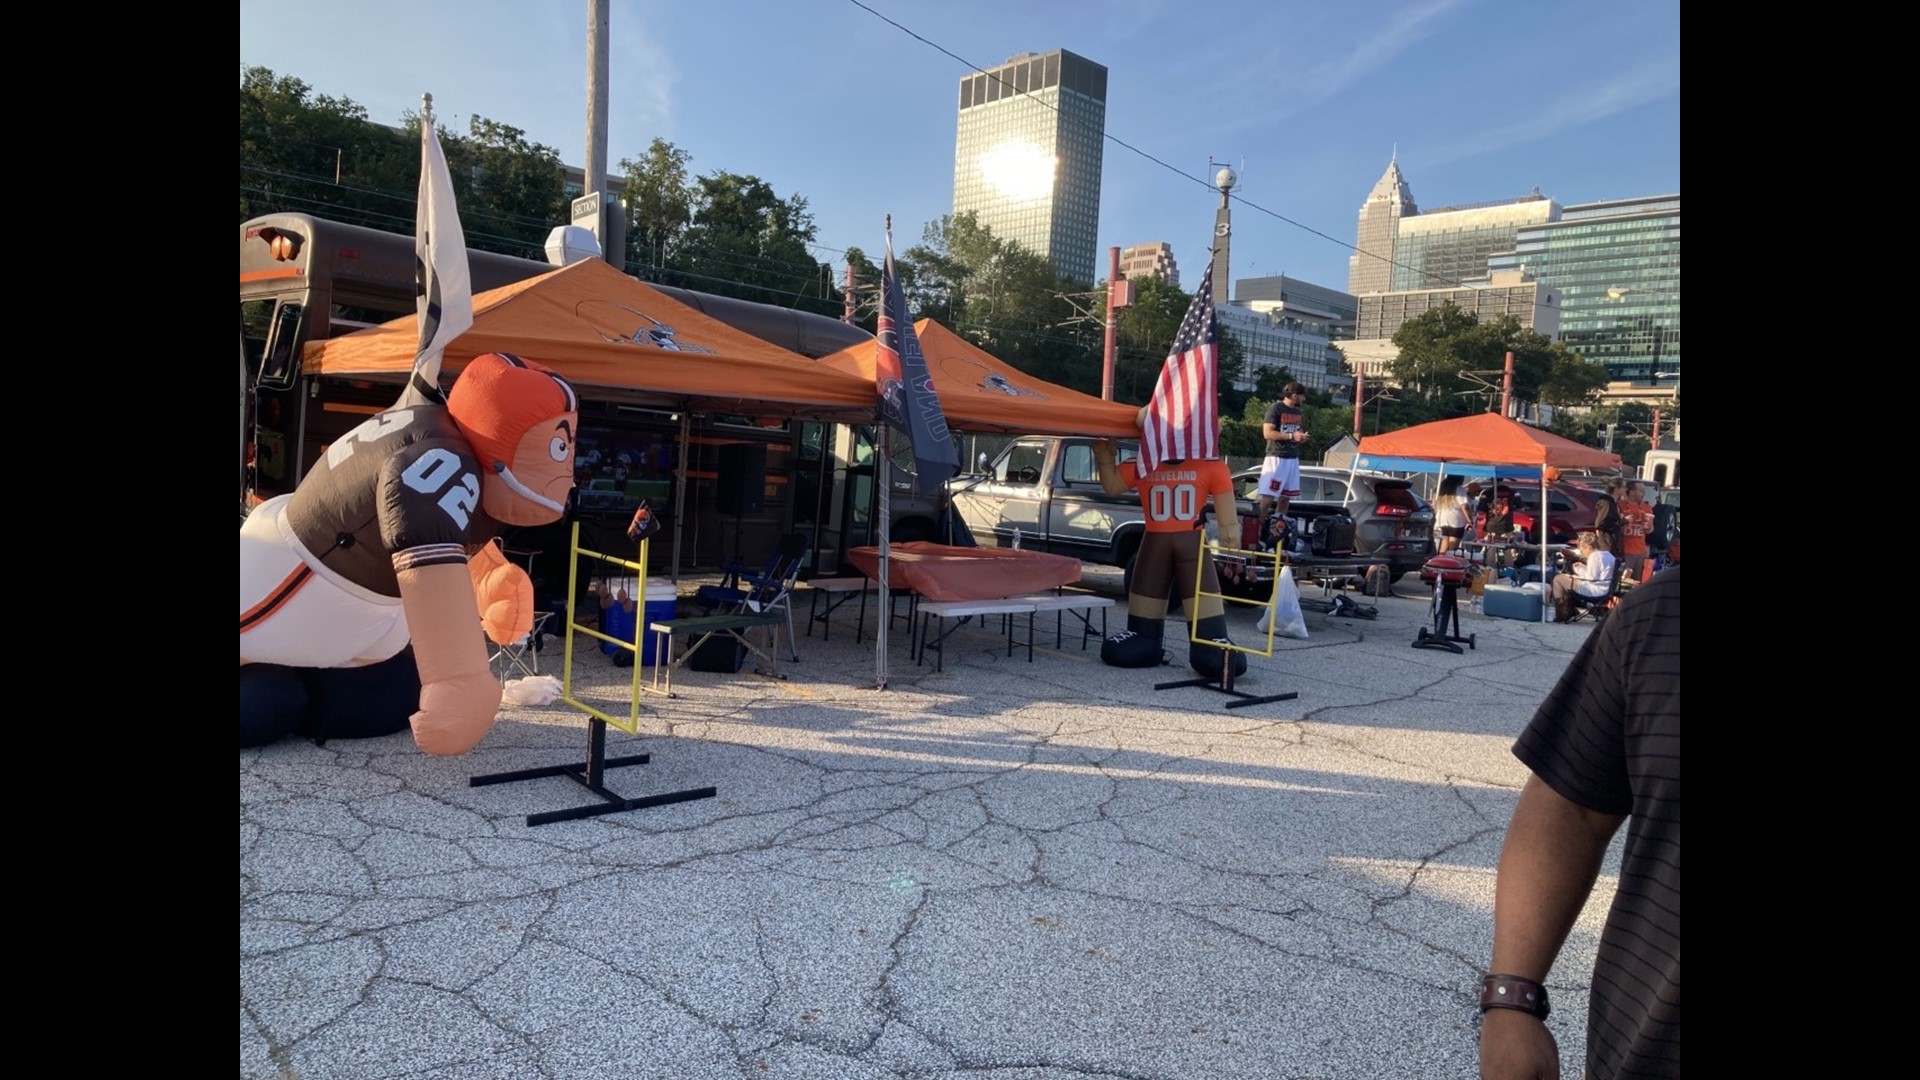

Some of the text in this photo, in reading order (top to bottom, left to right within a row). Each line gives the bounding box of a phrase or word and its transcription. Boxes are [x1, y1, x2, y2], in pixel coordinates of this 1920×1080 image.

[574, 200, 597, 216] SECTION
[1215, 222, 1230, 237] 3
[401, 448, 480, 532] 02
[1149, 484, 1196, 522] 00
